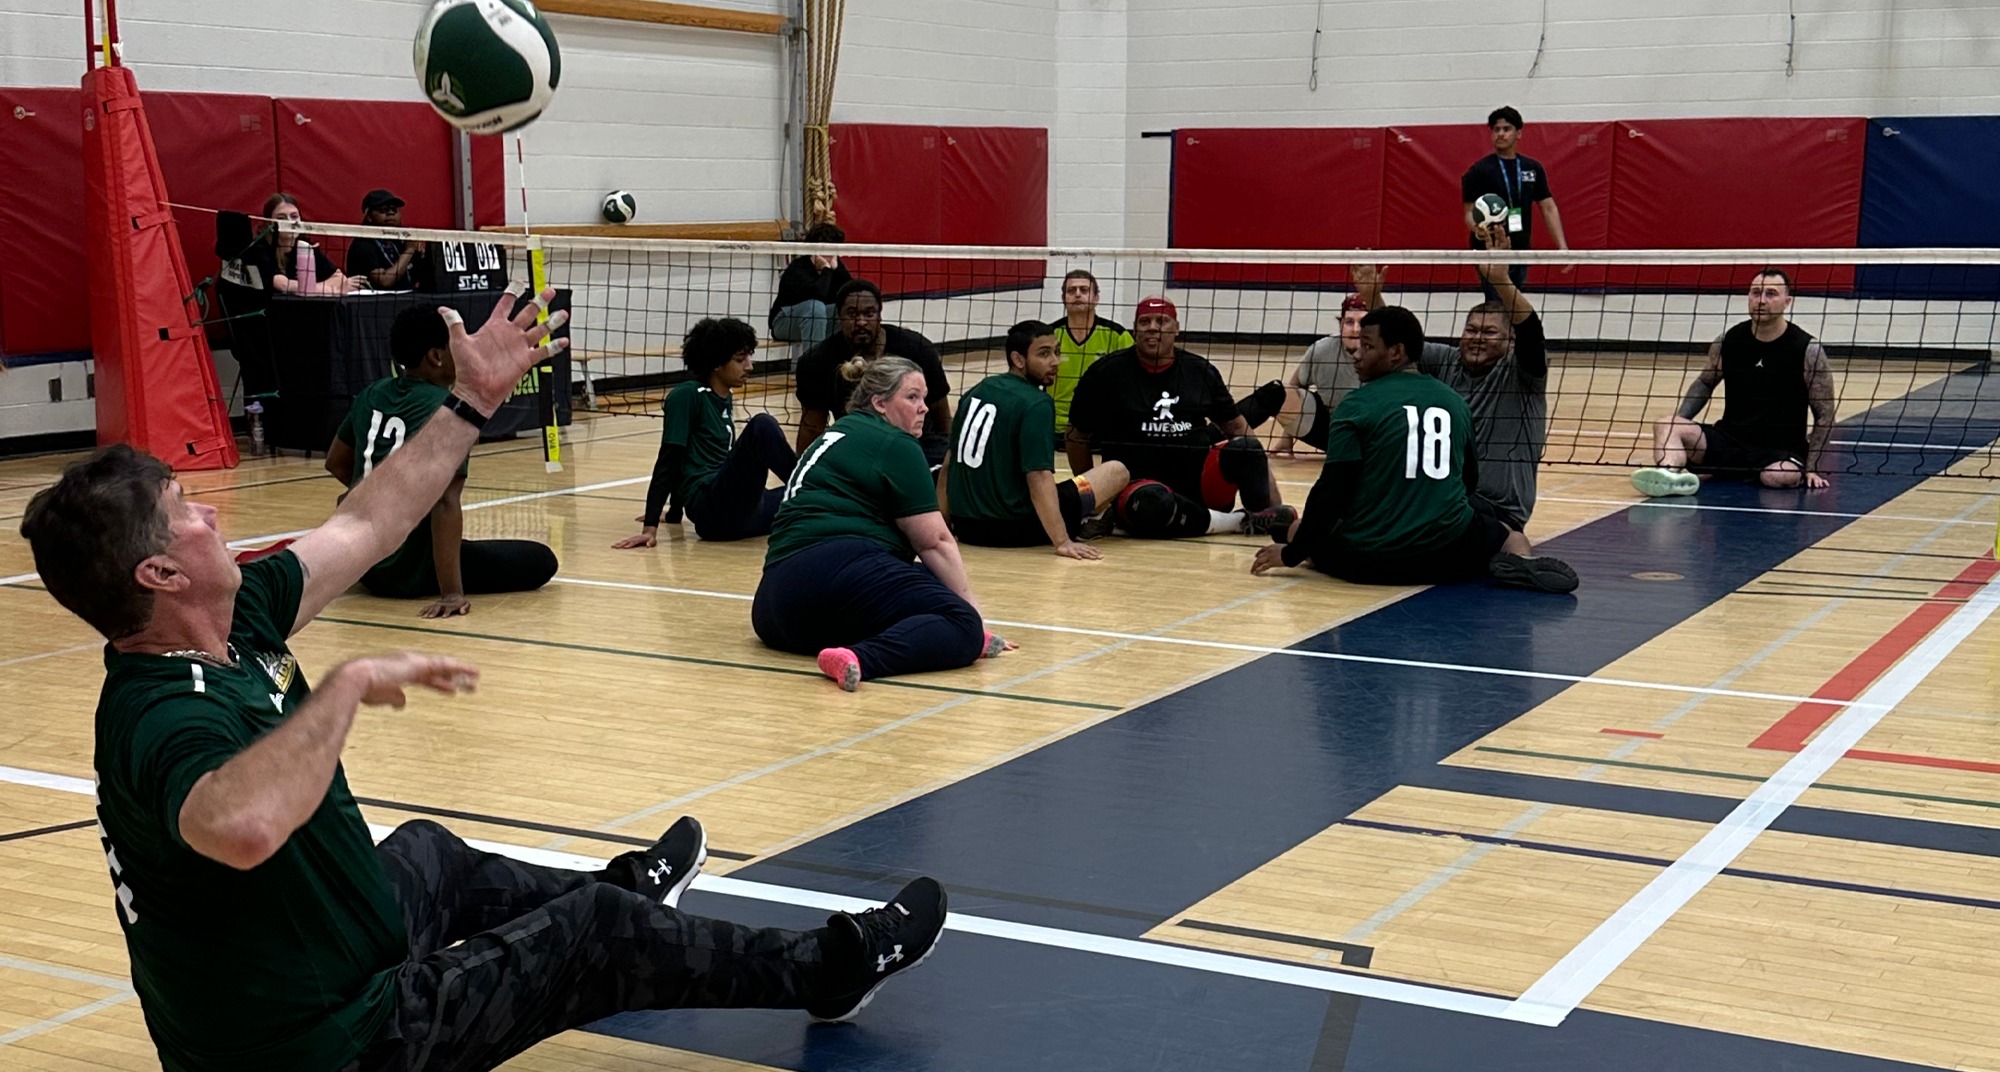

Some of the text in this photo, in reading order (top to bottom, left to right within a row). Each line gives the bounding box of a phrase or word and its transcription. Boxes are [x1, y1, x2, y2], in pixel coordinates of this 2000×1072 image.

[957, 396, 997, 469] 10
[1141, 421, 1192, 433] LIVEable
[1402, 405, 1451, 480] 18
